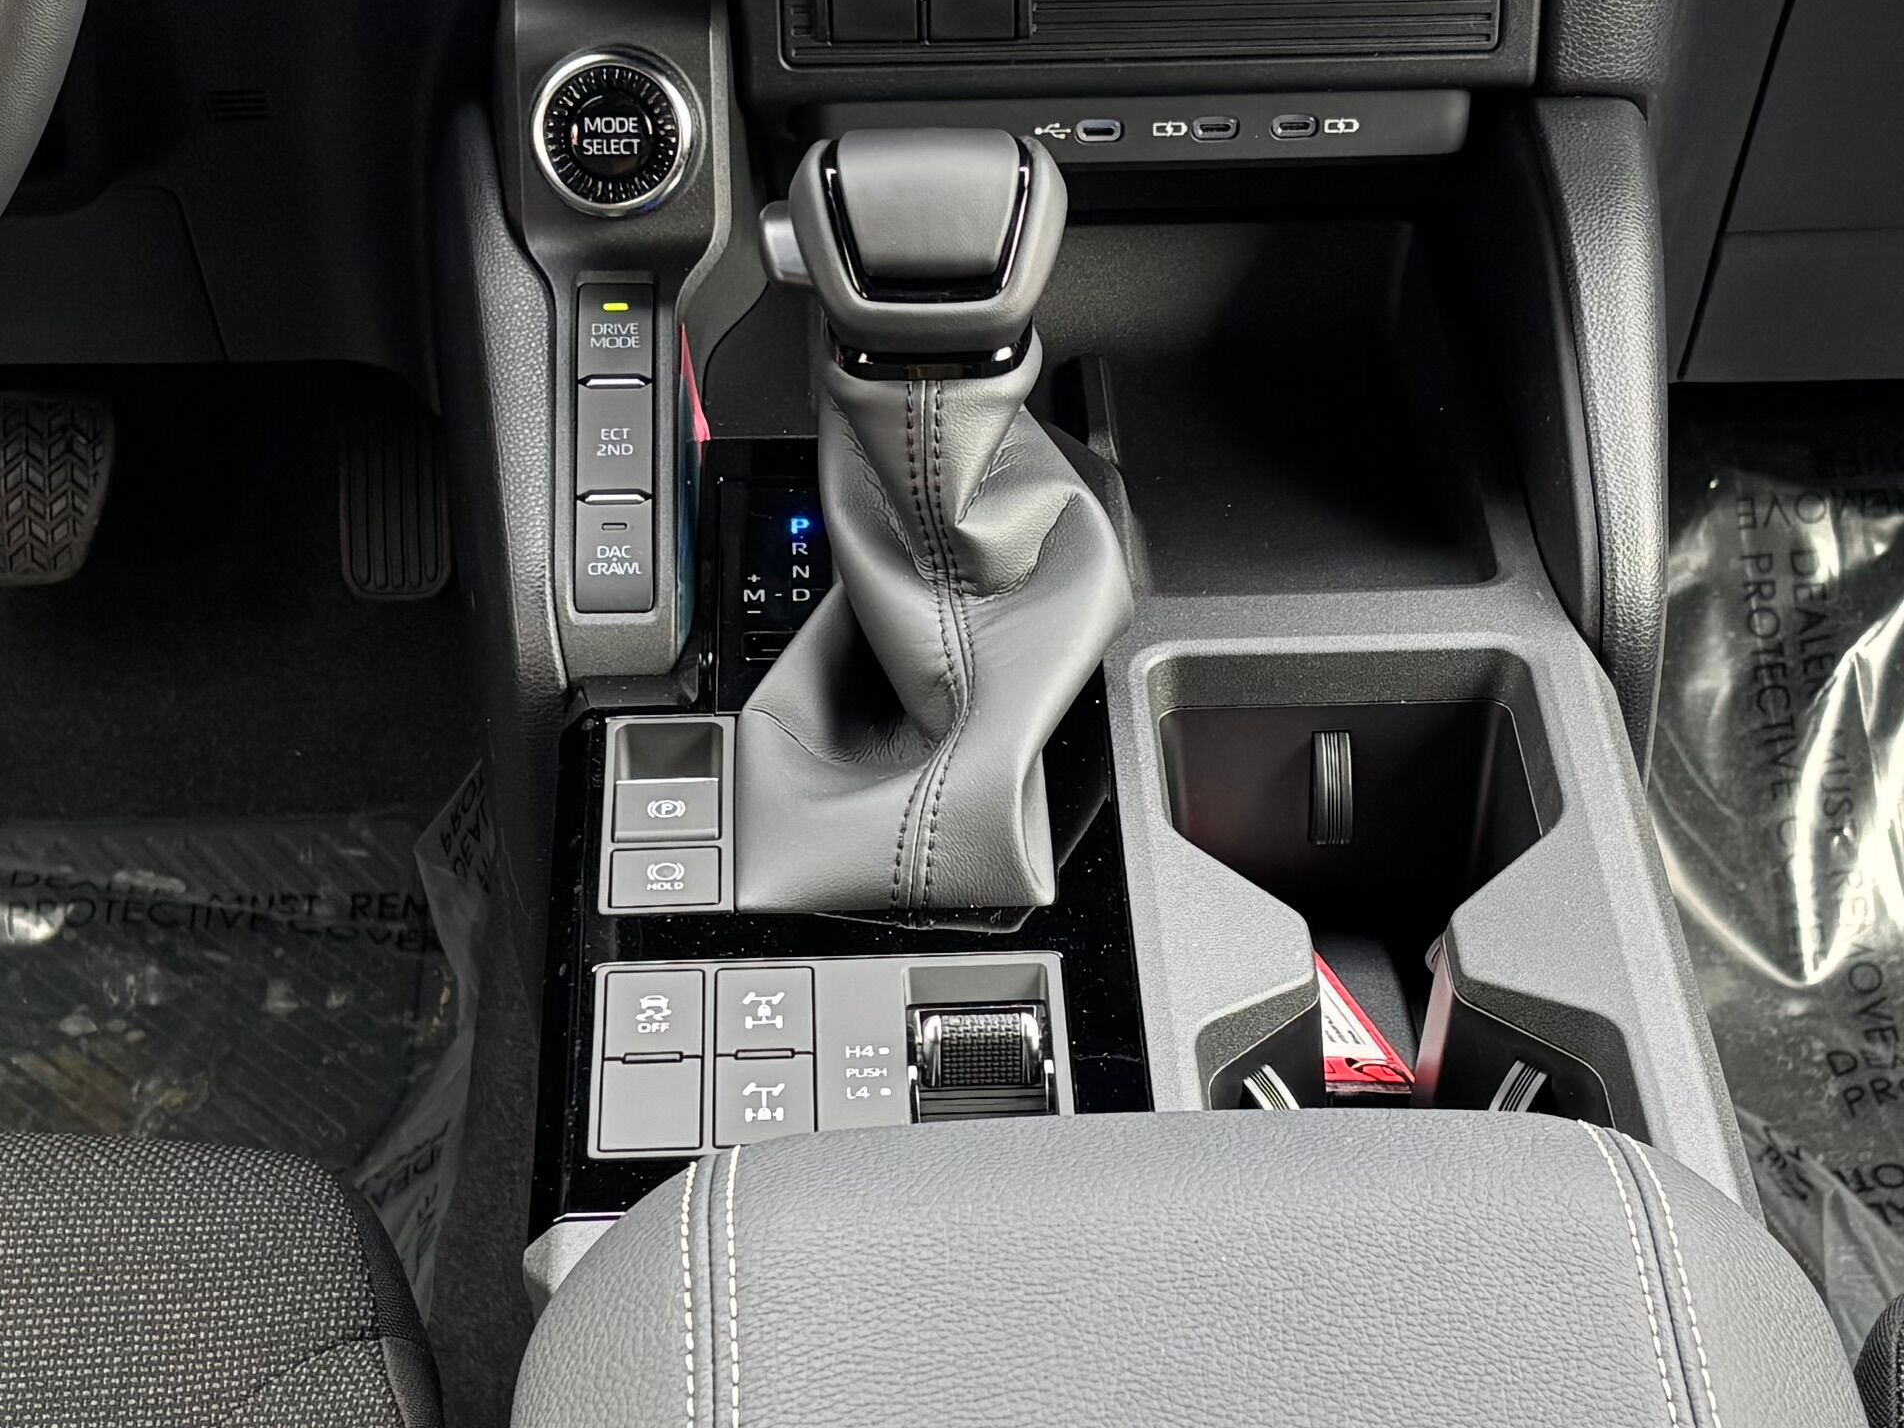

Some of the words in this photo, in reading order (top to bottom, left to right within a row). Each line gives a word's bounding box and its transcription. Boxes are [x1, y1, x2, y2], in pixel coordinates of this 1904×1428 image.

[582, 115, 639, 135] MODE
[581, 136, 641, 158] SELECT
[590, 321, 640, 337] DRIVE
[589, 334, 641, 350] MODE
[599, 426, 631, 442] ECT
[595, 441, 635, 458] 2ND
[790, 517, 810, 534] P
[595, 543, 633, 559] DAC
[791, 540, 809, 556] R
[586, 559, 643, 577] CRAWL
[792, 564, 810, 579] N
[743, 587, 766, 603] M
[792, 587, 811, 603] D
[646, 880, 685, 891] HOLD
[637, 1021, 670, 1033] OFF
[845, 1044, 874, 1058] H4
[845, 1066, 888, 1078] PUSH
[846, 1086, 871, 1099] L4
